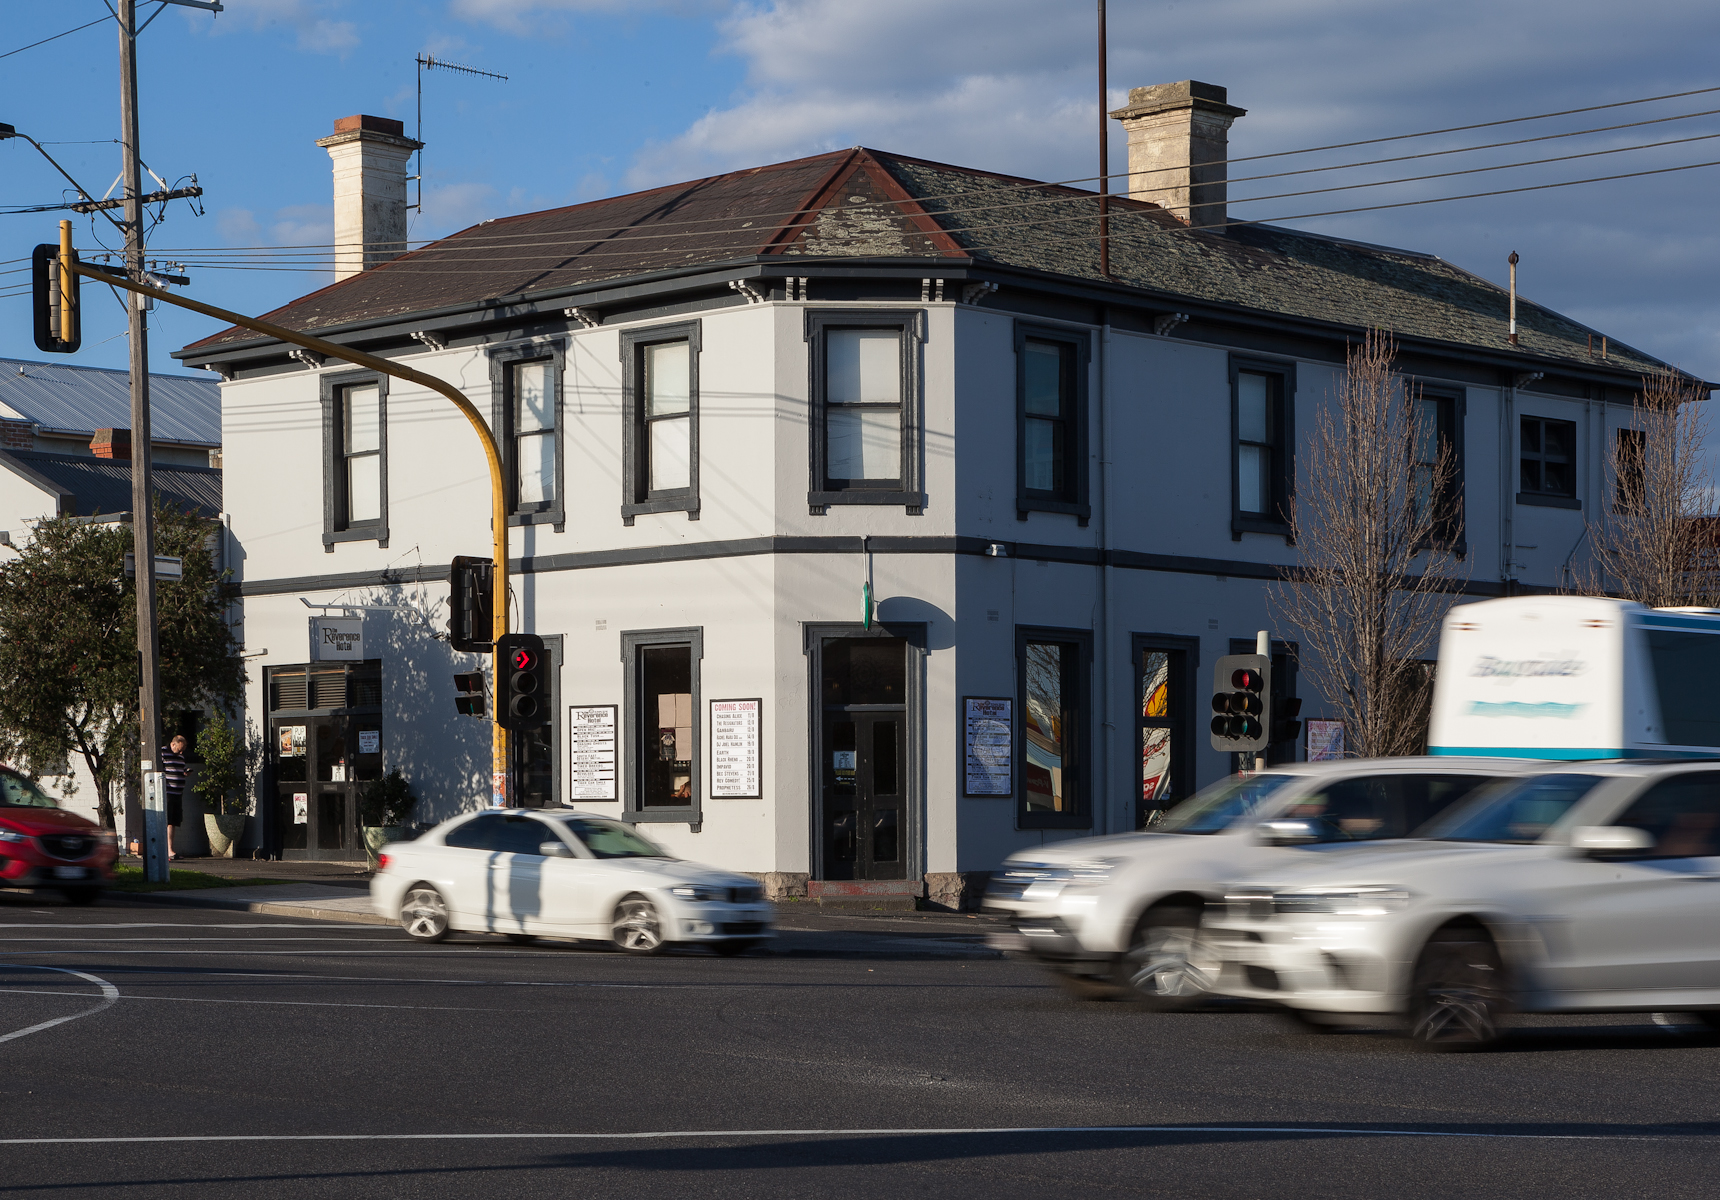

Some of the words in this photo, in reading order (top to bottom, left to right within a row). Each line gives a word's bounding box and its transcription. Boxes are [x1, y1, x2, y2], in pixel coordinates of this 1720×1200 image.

[322, 628, 360, 644] Reverence
[336, 641, 352, 651] Hotel
[739, 702, 756, 710] SOON!
[576, 712, 608, 720] Reverence
